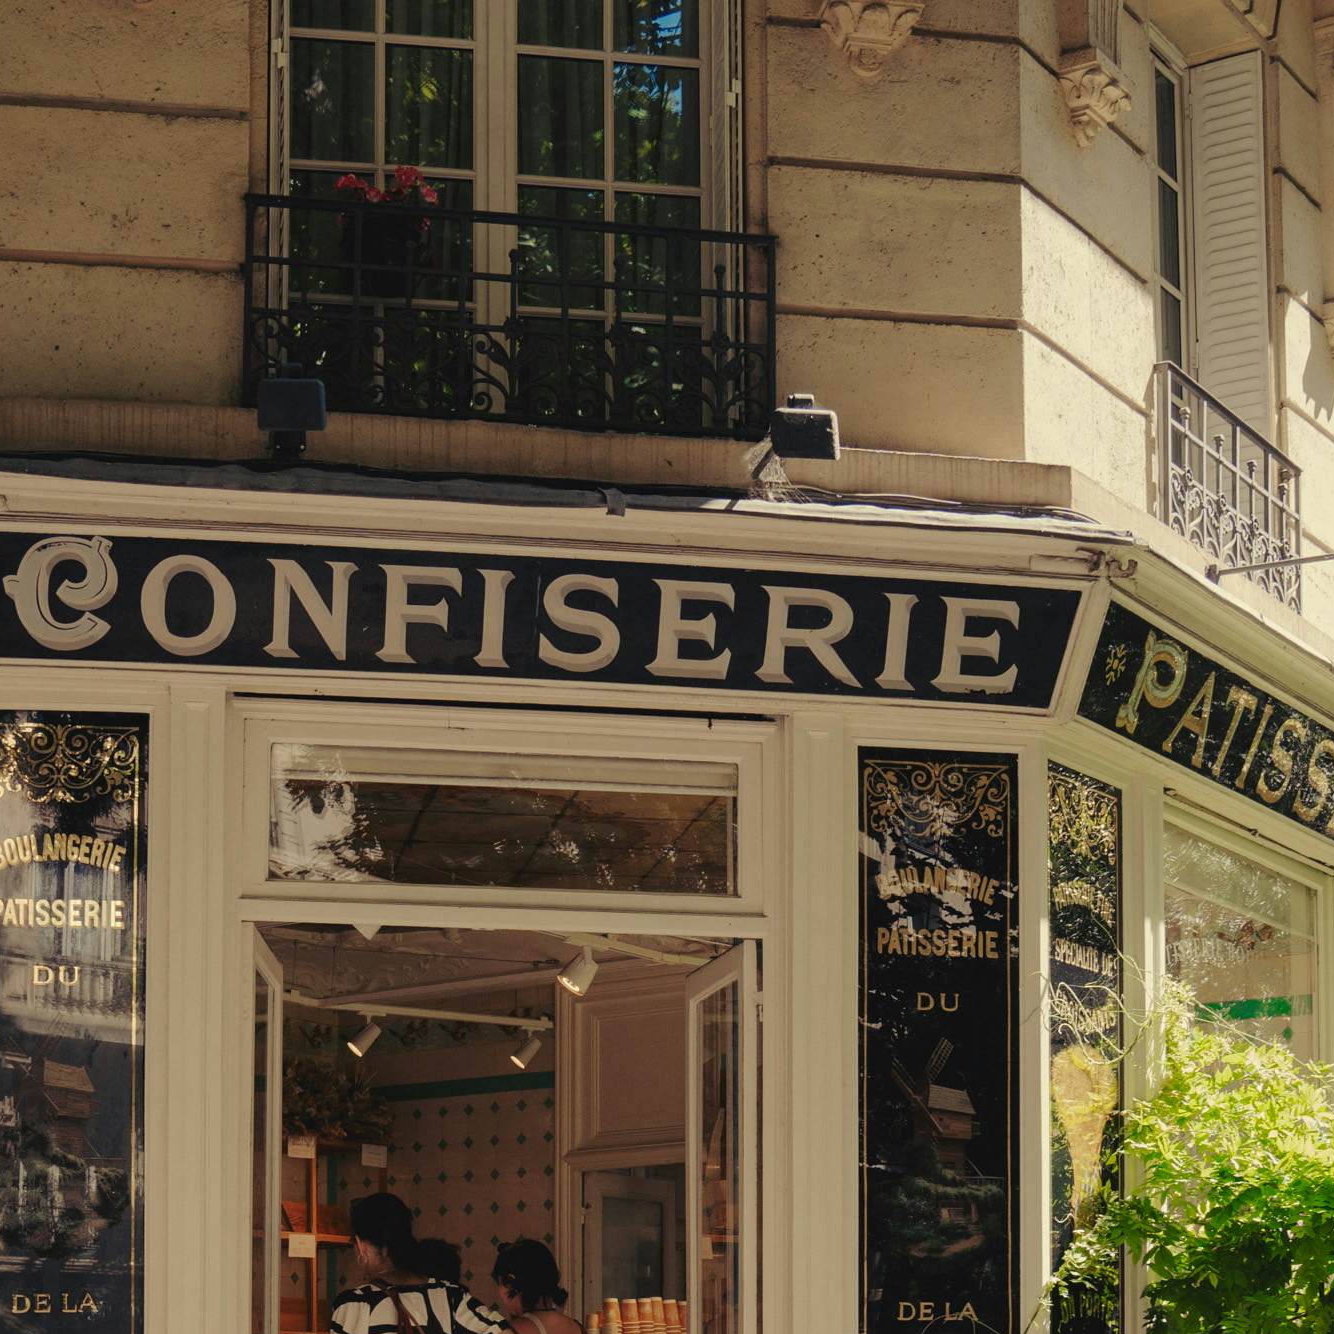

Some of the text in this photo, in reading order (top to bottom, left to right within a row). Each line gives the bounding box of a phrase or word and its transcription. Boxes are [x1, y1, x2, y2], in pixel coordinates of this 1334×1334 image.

[3, 534, 1021, 696] CONFISERIE
[874, 865, 1002, 906] BOULANGERIE
[877, 926, 999, 959] PATISSERIE
[32, 965, 81, 986] DU
[916, 992, 960, 1012] DU
[11, 1293, 99, 1314] DE LA
[897, 1301, 979, 1322] DE LA
